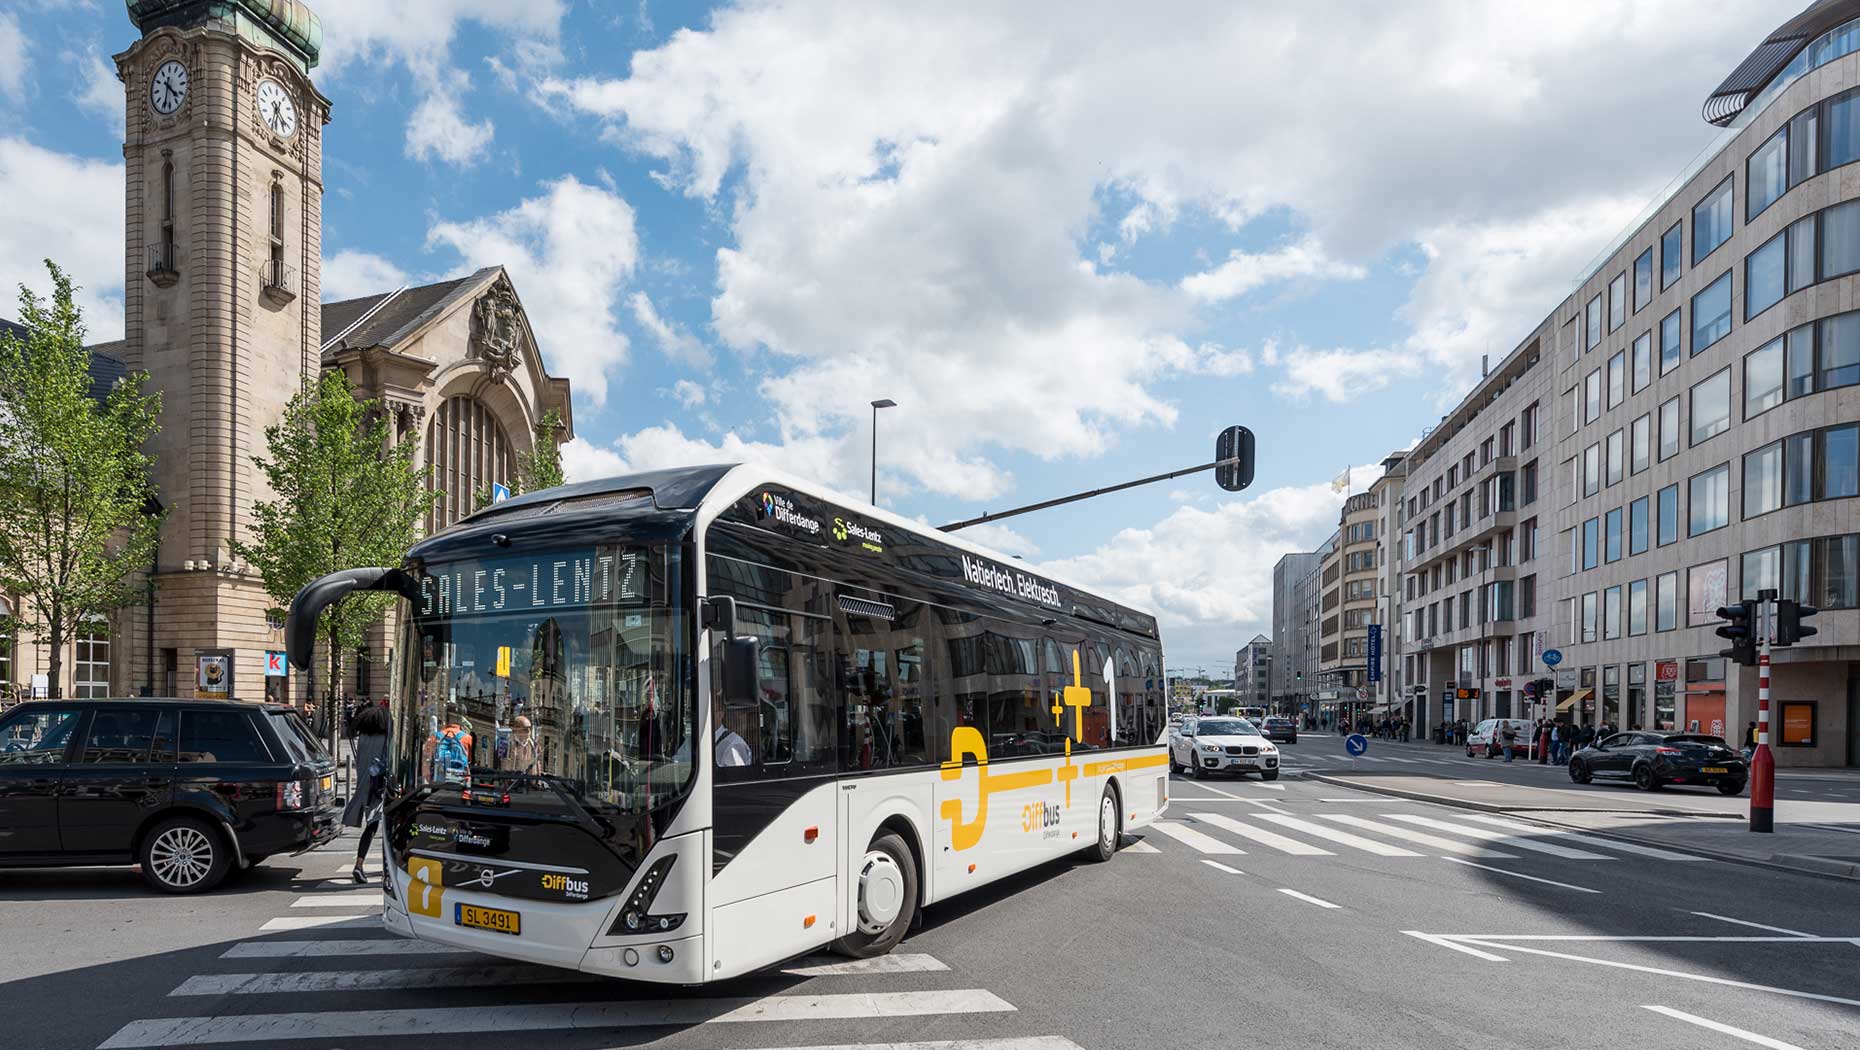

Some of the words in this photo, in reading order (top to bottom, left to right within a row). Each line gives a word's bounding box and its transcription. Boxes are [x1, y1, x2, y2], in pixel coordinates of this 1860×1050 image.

[774, 494, 785, 507] Ville
[786, 499, 794, 511] de
[775, 507, 820, 534] Differdange
[846, 521, 882, 543] Sales-Lentz
[421, 553, 636, 615] SALES-LENTZ
[962, 554, 1017, 595] Natierlech.
[1017, 573, 1062, 607] Elektresch.
[1021, 800, 1060, 833] Diffbus
[418, 823, 447, 836] Sales-Lentz
[541, 874, 589, 893] Diffbus
[467, 908, 480, 924] SL
[483, 911, 511, 929] 3491
